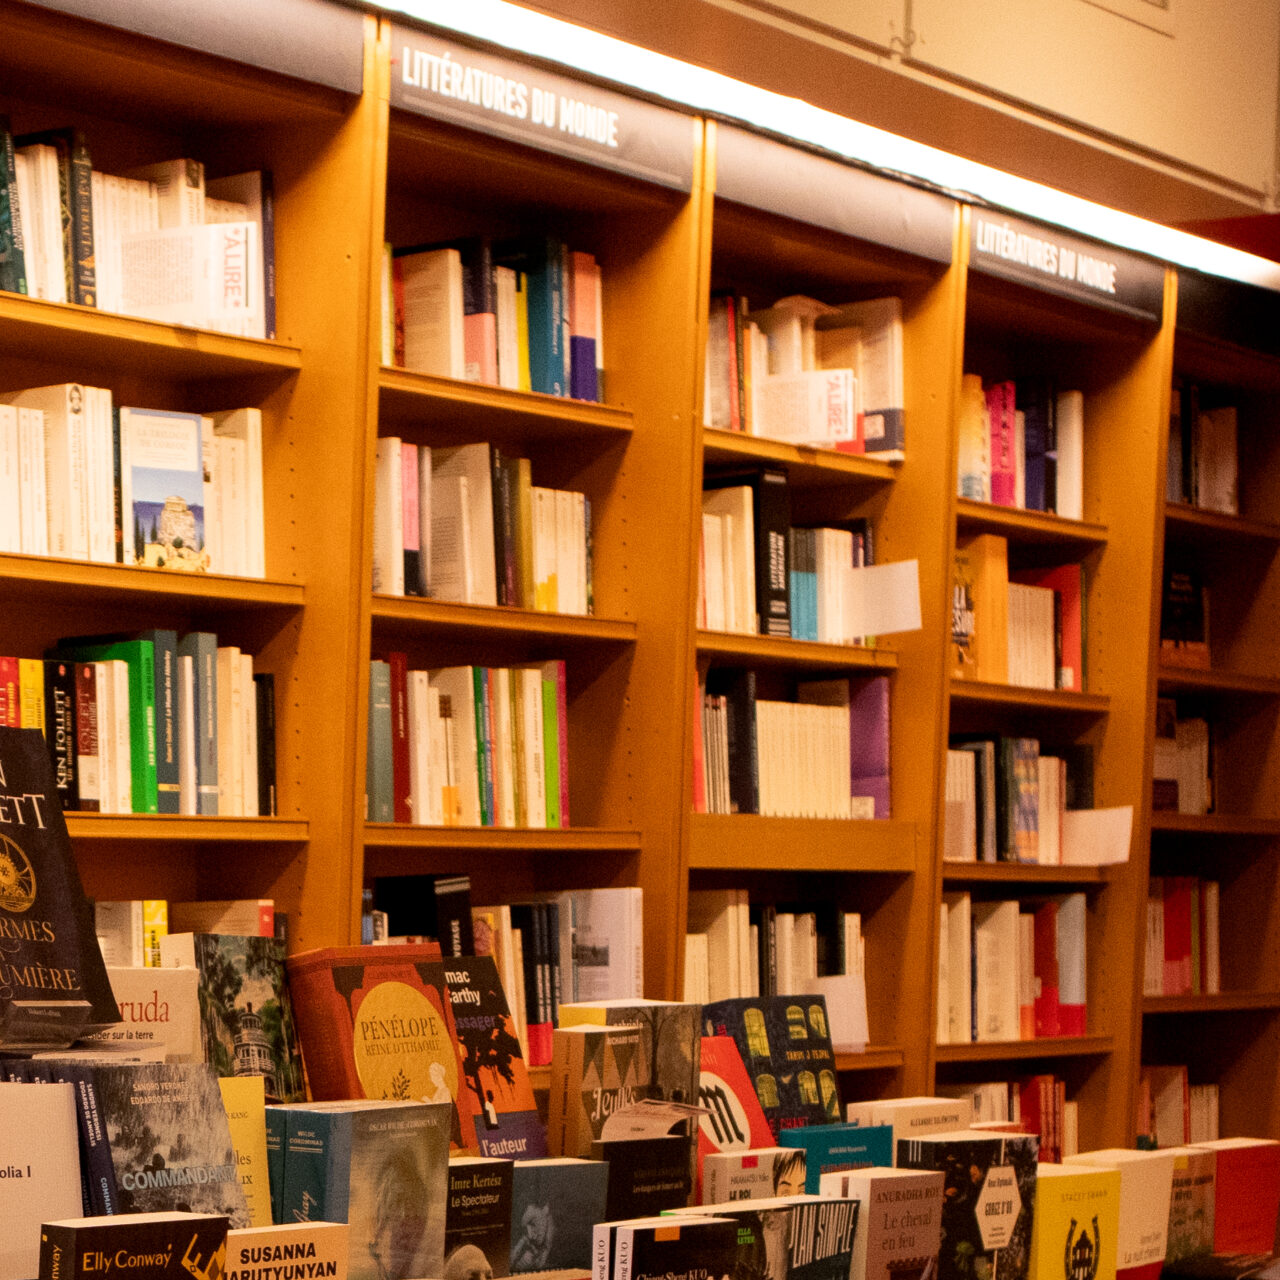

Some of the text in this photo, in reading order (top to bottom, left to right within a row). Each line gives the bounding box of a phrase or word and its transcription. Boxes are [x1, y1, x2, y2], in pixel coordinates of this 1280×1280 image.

[401, 46, 619, 148] LITTÉRATURES DU MONDE
[976, 220, 1117, 294] LITTÉRATURES DU MONDE
[54, 686, 66, 789] KEN FOLLETT
[360, 1014, 439, 1041] PÉNÉLOPE
[482, 1137, 527, 1157] l'auteur
[26, 1165, 31, 1178] I
[82, 1249, 172, 1273] Elly Conway
[240, 1242, 316, 1264] SUSANNA
[687, 1269, 708, 1280] KUO
